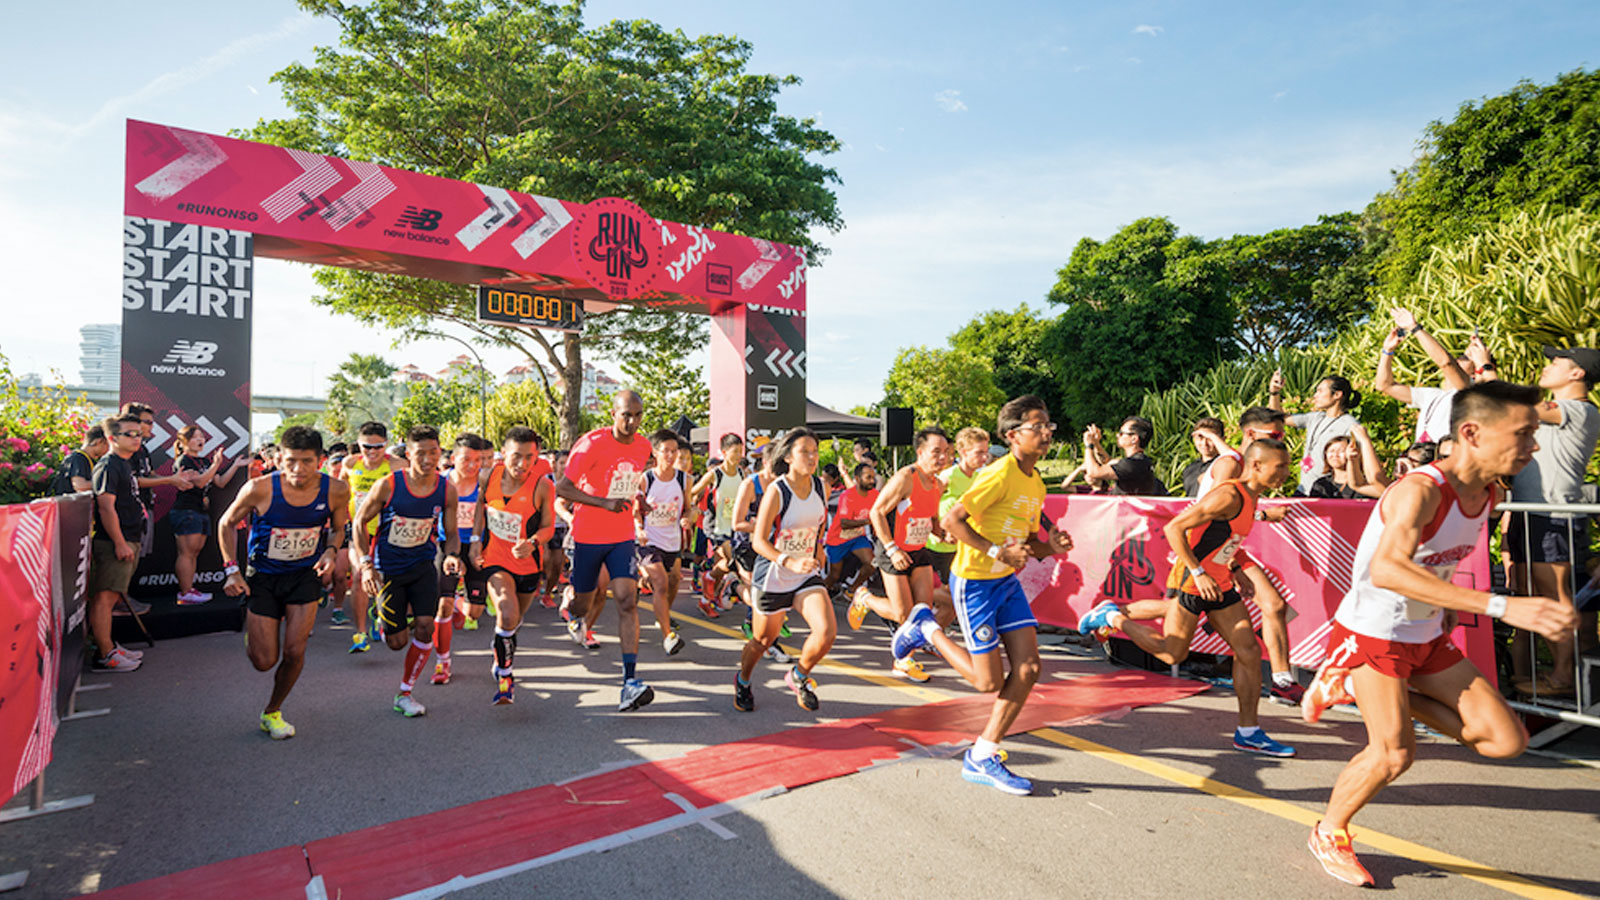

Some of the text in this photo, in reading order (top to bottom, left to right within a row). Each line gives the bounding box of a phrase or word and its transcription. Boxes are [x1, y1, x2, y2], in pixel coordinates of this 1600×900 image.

[177, 203, 259, 222] #RUNONSG
[123, 215, 253, 258] START
[383, 229, 450, 246] new balance
[599, 212, 641, 254] RUN
[123, 245, 252, 288] START
[607, 247, 631, 280] ON
[122, 277, 251, 319] START
[150, 365, 226, 377] new balance
[273, 537, 316, 550] E2190
[139, 571, 225, 586] #RUNNSG
